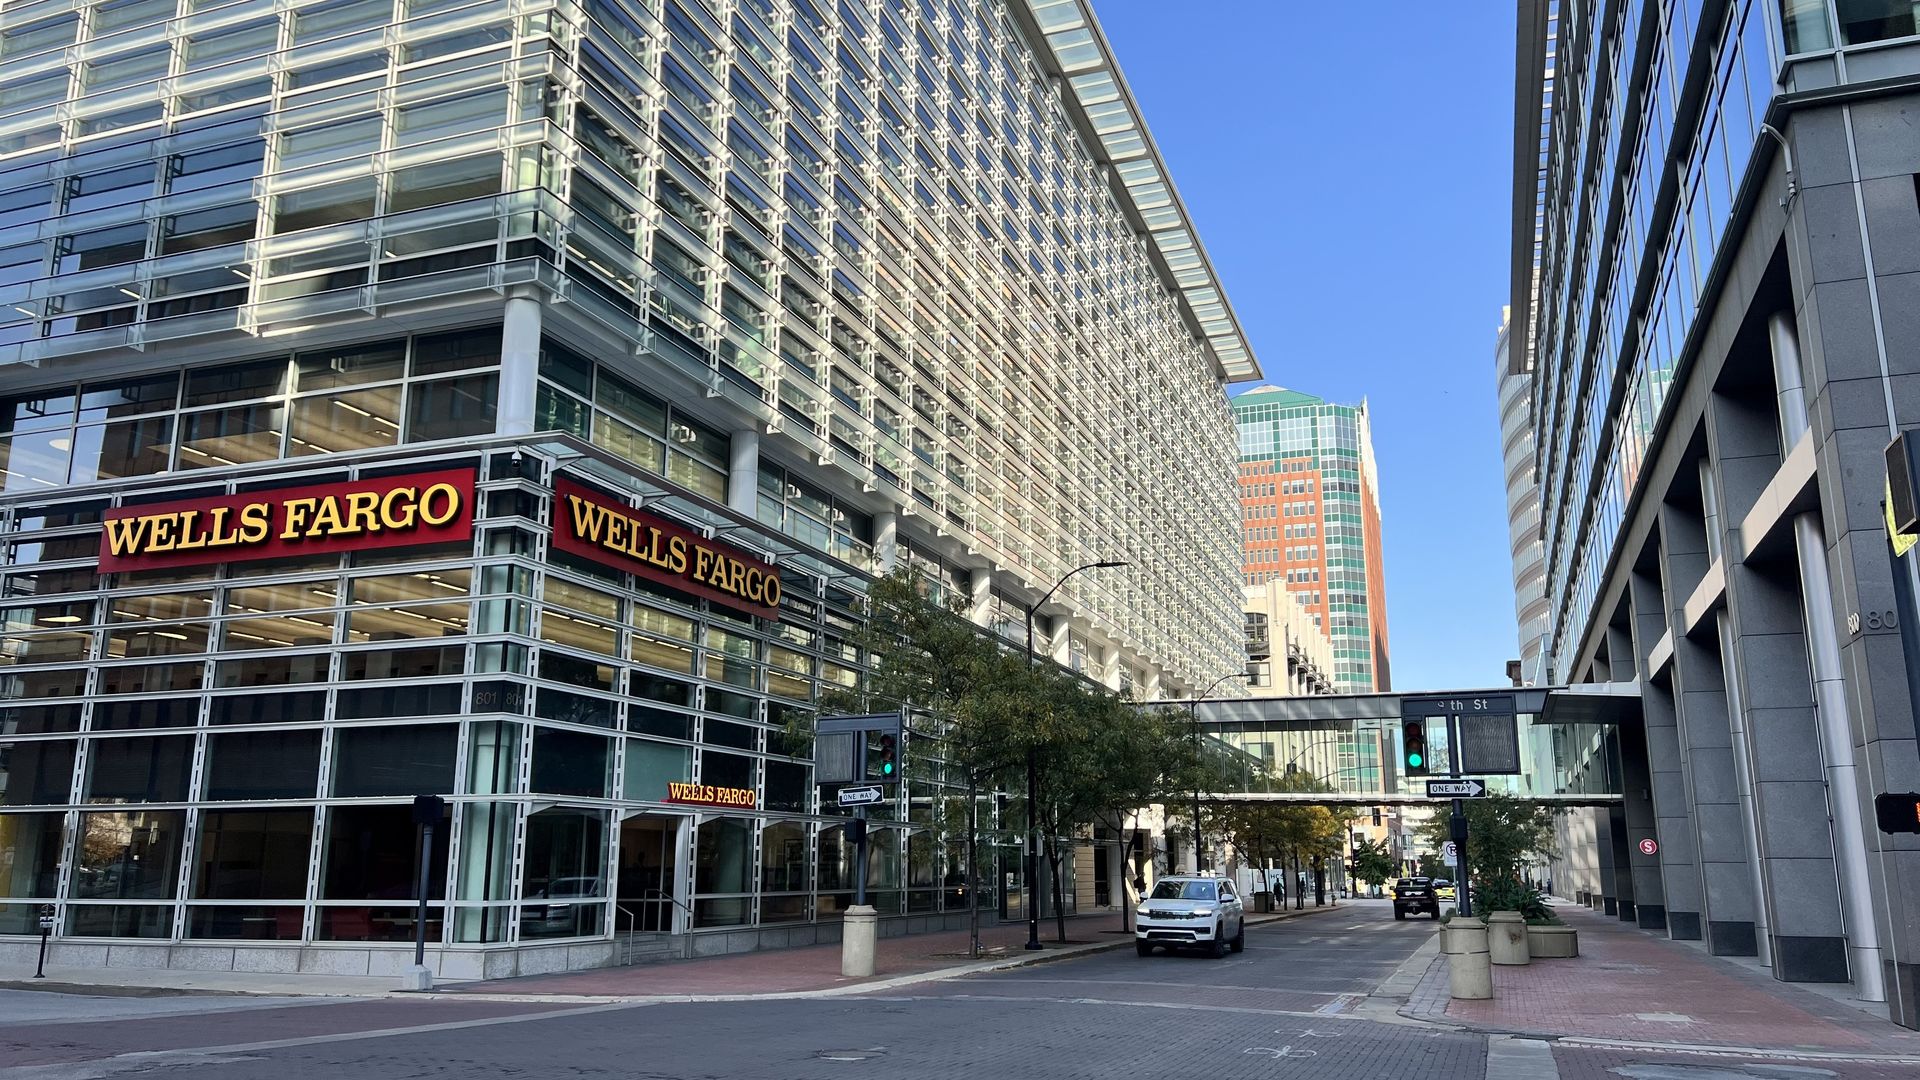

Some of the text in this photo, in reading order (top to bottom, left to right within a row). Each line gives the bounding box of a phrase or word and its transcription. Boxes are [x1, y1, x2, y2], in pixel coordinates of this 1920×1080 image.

[104, 483, 460, 555] WELLS FARGO
[570, 494, 781, 607] WELLS FARGO
[1867, 609, 1898, 629] 80
[475, 691, 497, 705] 801
[1473, 698, 1488, 710] St
[670, 782, 755, 806] WELLS FARGO
[1432, 784, 1472, 793] ONE WAY
[843, 791, 873, 801] ONE WAY
[1644, 841, 1653, 853] S
